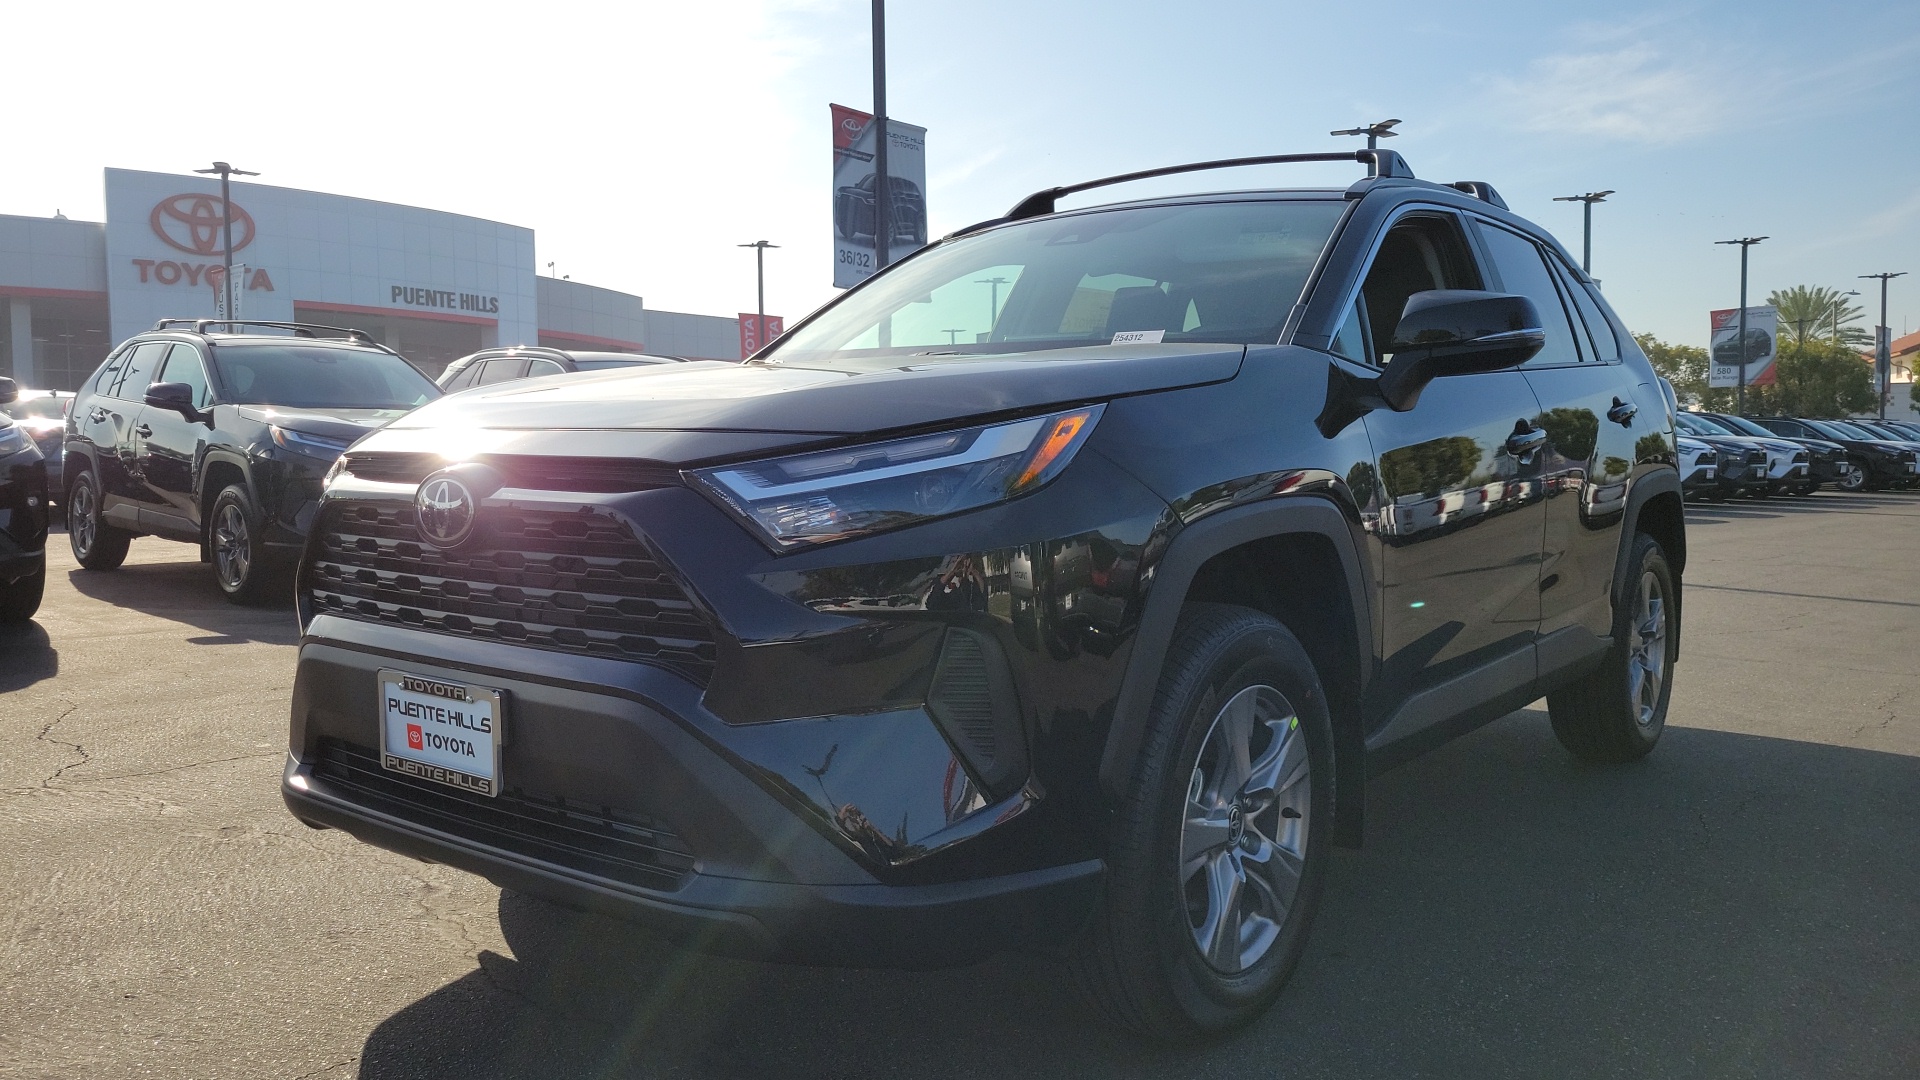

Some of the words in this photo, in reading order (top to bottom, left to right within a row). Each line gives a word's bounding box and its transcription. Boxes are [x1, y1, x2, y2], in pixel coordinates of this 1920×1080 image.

[900, 142, 919, 151] TOYOTA
[839, 249, 870, 268] 36/32
[132, 259, 275, 291] TOYOA
[391, 285, 456, 309] PUENTE
[460, 293, 499, 313] HILLS
[404, 678, 465, 699] TOYOTA
[388, 698, 447, 724] PUENTE
[448, 709, 491, 733] HILLS
[425, 732, 475, 758] TOYOTA
[386, 757, 444, 780] PUENTE
[446, 771, 489, 792] HILLS
